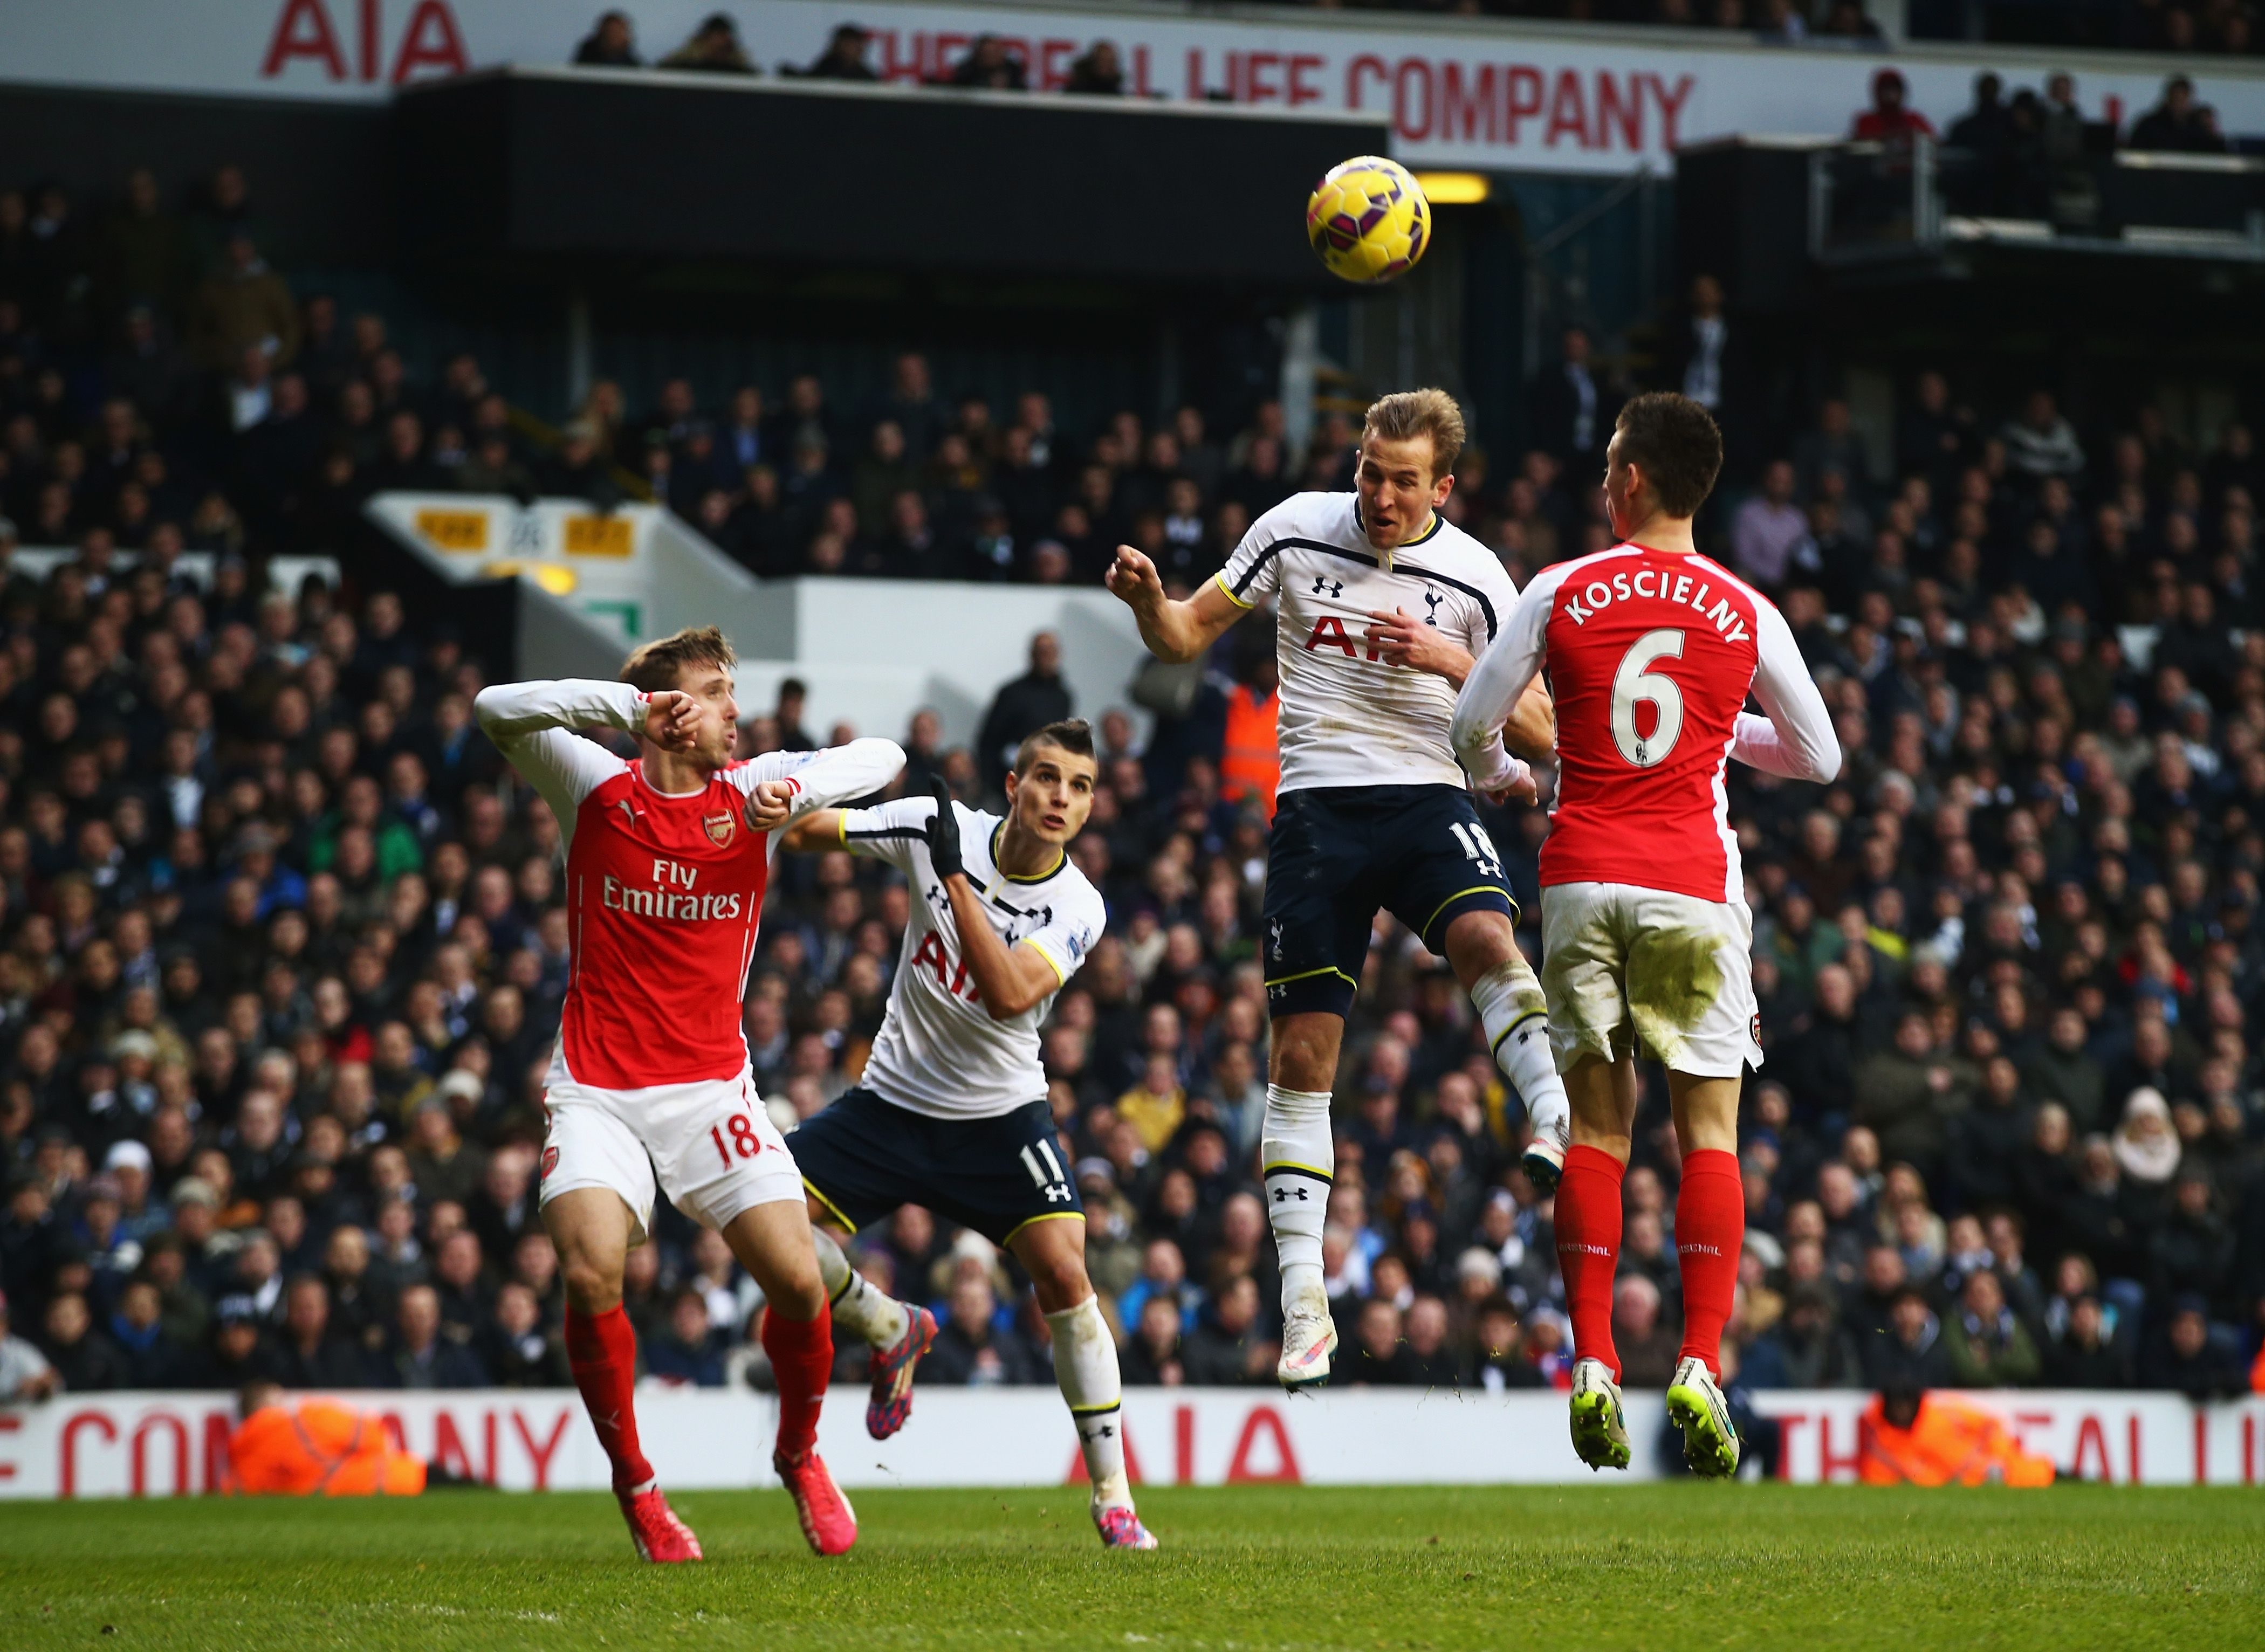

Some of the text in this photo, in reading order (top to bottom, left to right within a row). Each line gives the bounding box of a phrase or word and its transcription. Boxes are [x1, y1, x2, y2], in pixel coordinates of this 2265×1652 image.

[262, 0, 468, 84] AIA
[1344, 52, 1694, 152] COMPANY
[1564, 570, 1751, 643] KOSCIELNY
[1305, 616, 1399, 667] AI
[1610, 627, 1685, 768] 6
[1449, 822, 1500, 865] 18
[603, 875, 741, 920] Emirates
[652, 859, 697, 890] Fly
[711, 1114, 760, 1172] 18
[1019, 1138, 1065, 1189] 11
